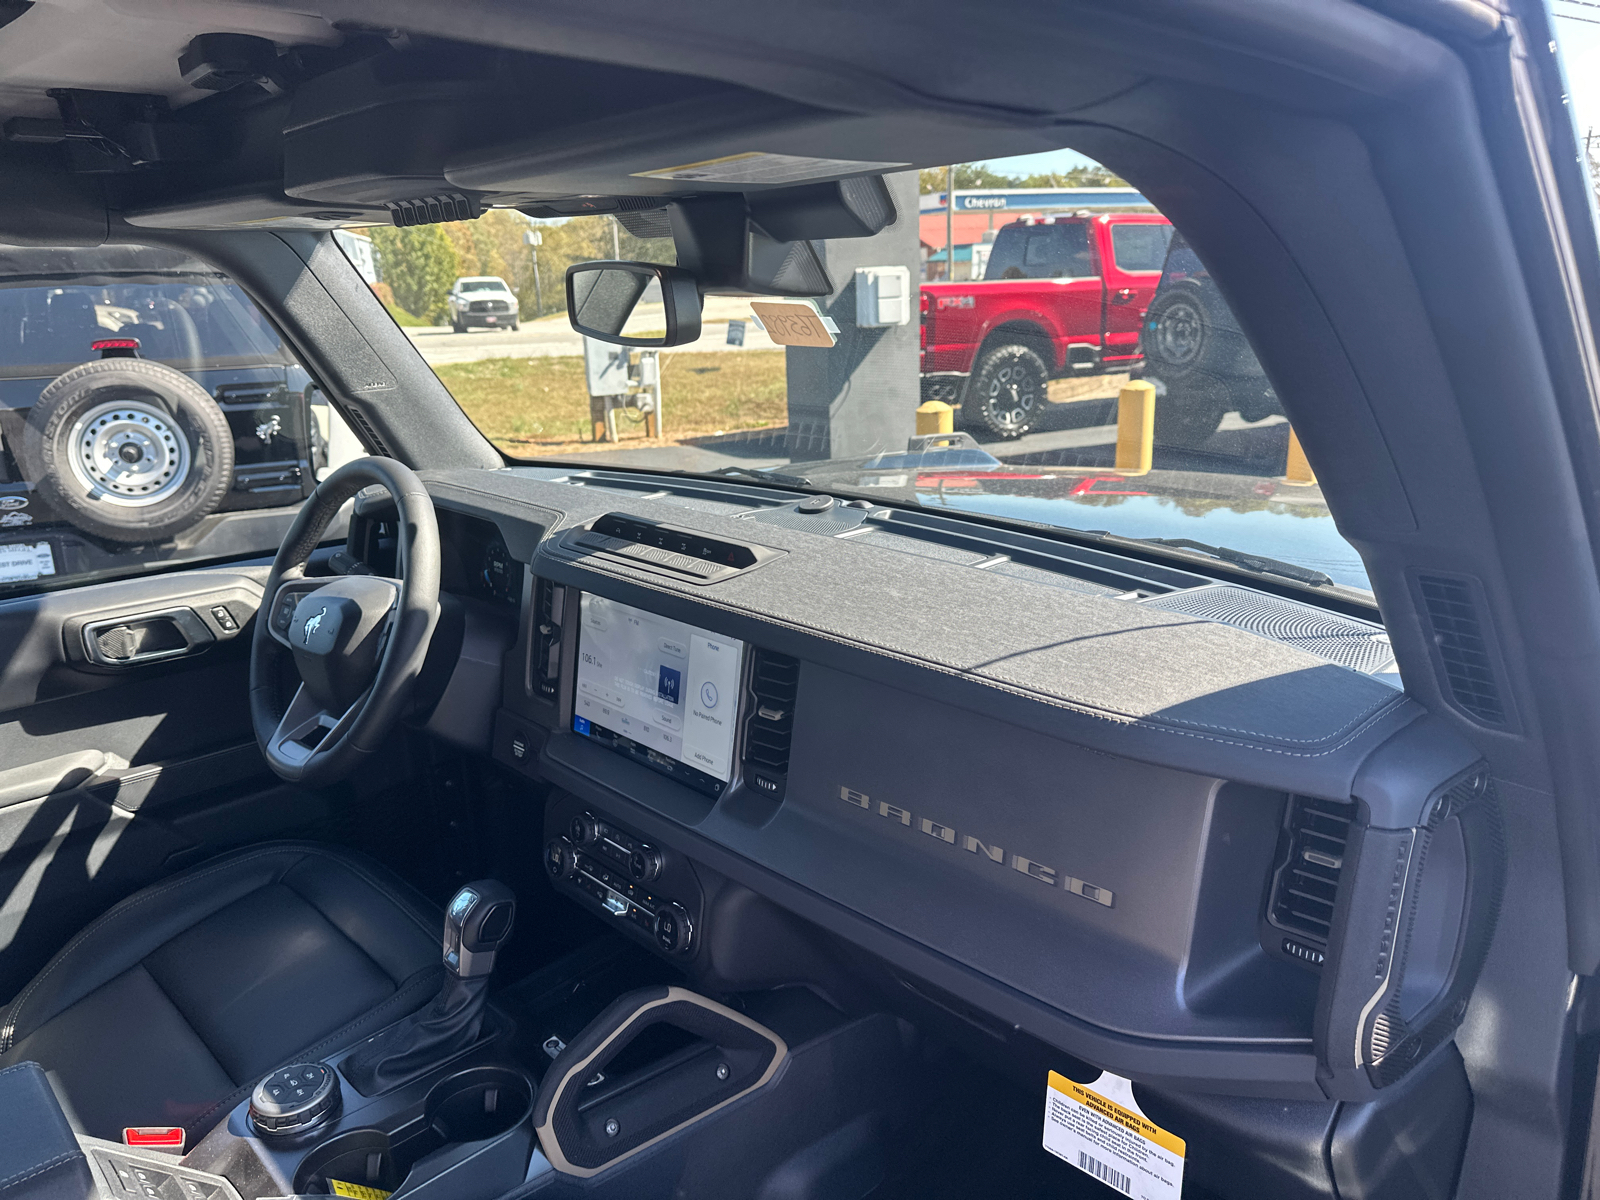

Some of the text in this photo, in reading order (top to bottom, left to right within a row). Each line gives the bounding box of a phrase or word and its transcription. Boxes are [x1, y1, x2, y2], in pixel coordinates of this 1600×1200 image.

[964, 196, 1007, 209] Chevron
[582, 652, 596, 666] 106.1
[708, 642, 720, 652] Phone
[662, 714, 672, 724] Sound
[693, 710, 722, 726] No Paired Phone
[701, 754, 714, 766] Phone
[838, 786, 1113, 907] BRONCO
[1052, 1106, 1064, 1116] Never
[1085, 1124, 1099, 1136] facing
[1100, 1132, 1111, 1142] child
[1061, 1106, 1071, 1115] back
[1072, 1085, 1084, 1096] THIS
[1086, 1092, 1106, 1108] VEHICLE
[1114, 1108, 1140, 1126] EQUIPPED
[1142, 1122, 1157, 1134] WITH
[1078, 1105, 1090, 1114] EVEN
[1090, 1112, 1102, 1120] WITH
[1102, 1118, 1124, 1134] ADVANCED
[1134, 1134, 1146, 1145] BAGS
[1086, 1100, 1140, 1133] ADVANCED AIR BAGS
[1051, 1112, 1066, 1123] Always
[1106, 1142, 1118, 1151] child
[1052, 1097, 1070, 1110] Children
[1086, 1115, 1098, 1124] killed
[1104, 1126, 1124, 1140] seriously
[1125, 1136, 1142, 1148] injured
[1149, 1149, 1157, 1157] the
[1164, 1158, 1175, 1168] bag.
[1051, 1116, 1059, 1124] See
[1077, 1131, 1093, 1142] manual
[1100, 1144, 1112, 1153] more
[1112, 1150, 1139, 1168] information
[1139, 1166, 1153, 1176] about
[1160, 1176, 1174, 1188] bags.
